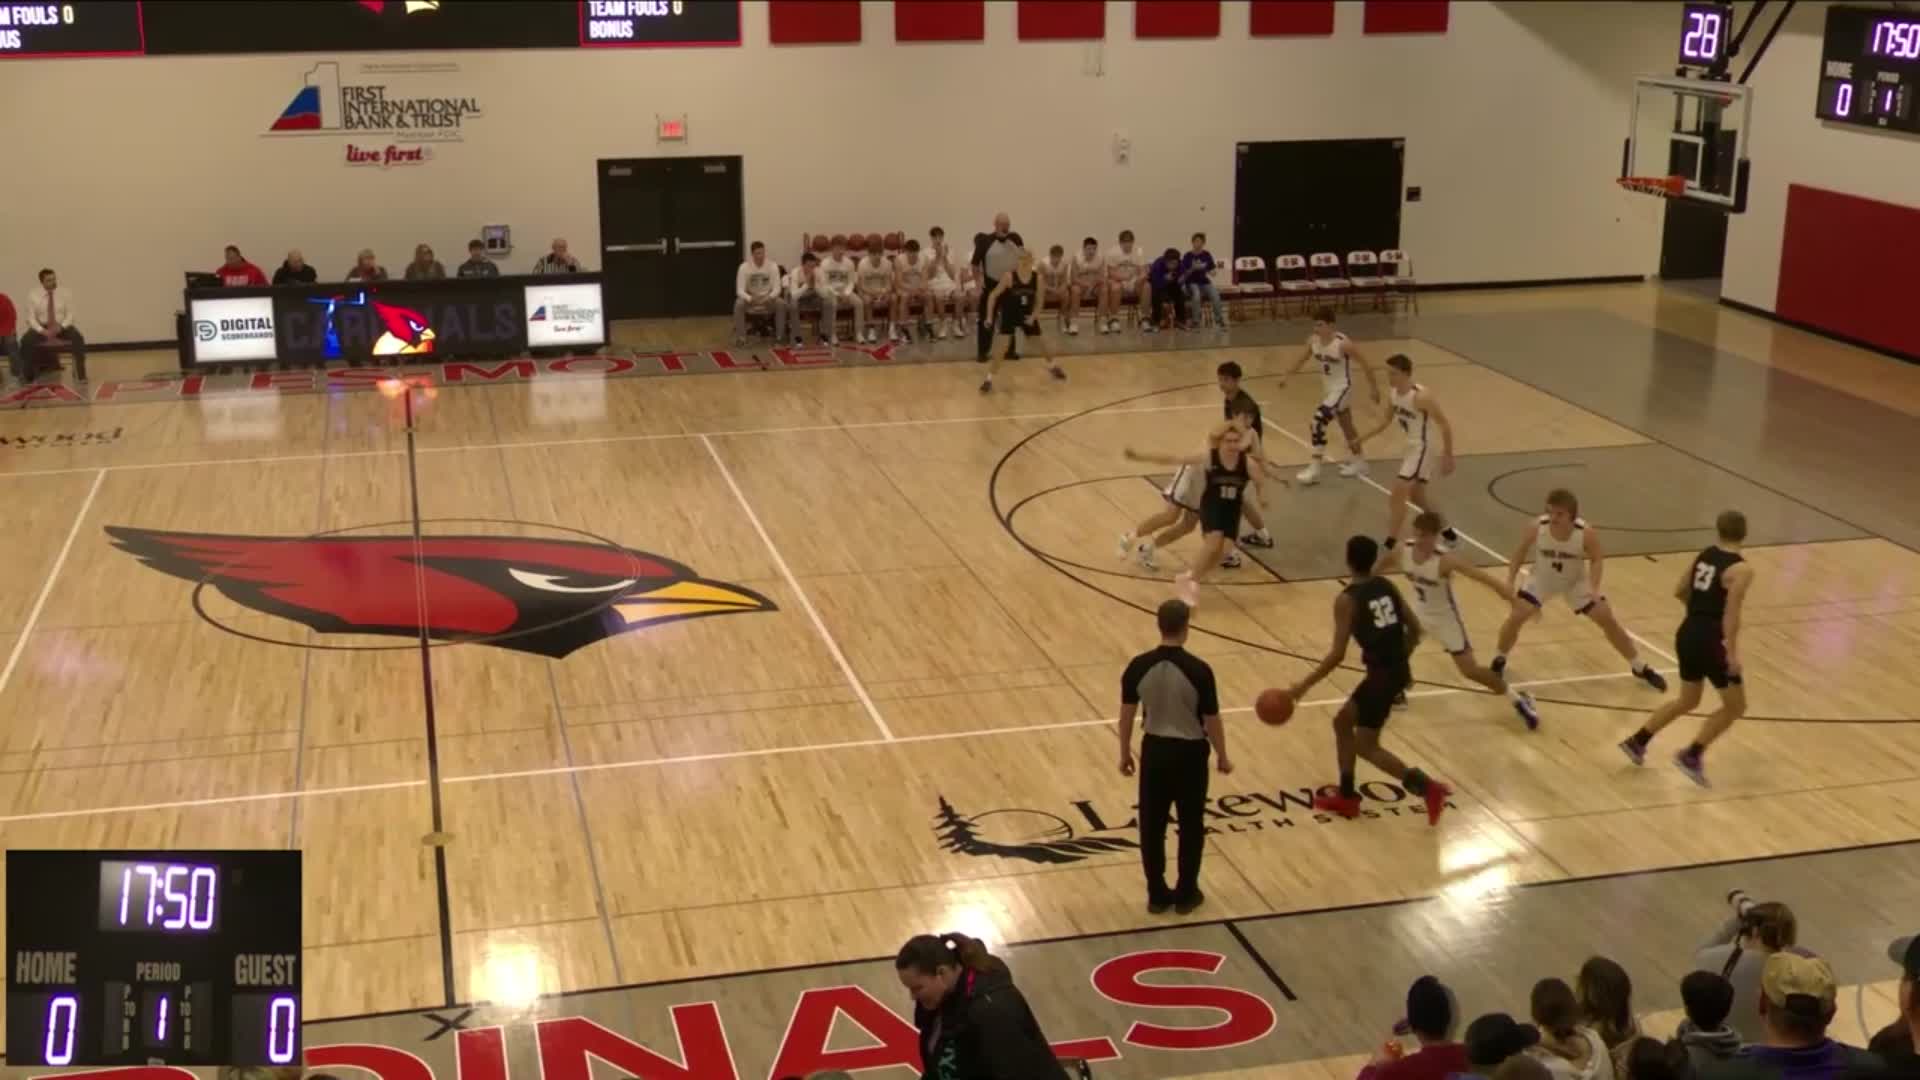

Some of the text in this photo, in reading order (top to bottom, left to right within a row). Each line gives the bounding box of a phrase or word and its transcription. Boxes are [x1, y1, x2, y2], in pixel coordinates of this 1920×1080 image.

[12, 5, 59, 25] FOULS
[589, 1, 626, 16] TEAM
[627, 1, 669, 16] FOULS
[0, 29, 21, 49] US
[589, 20, 634, 39] BONUS
[1683, 13, 1720, 58] 28
[1872, 21, 1920, 58] 17:50
[342, 85, 386, 101] FIRST
[1836, 83, 1852, 116] 0
[343, 98, 480, 116] INTERNATIONAL
[344, 112, 463, 130] BANK & TRUST
[346, 144, 424, 166] live first
[220, 317, 273, 332] DIGITAL
[1693, 563, 1715, 591] 23
[1369, 596, 1398, 629] 32
[1070, 780, 1408, 832] Lewo
[1313, 801, 1457, 825] SSTE
